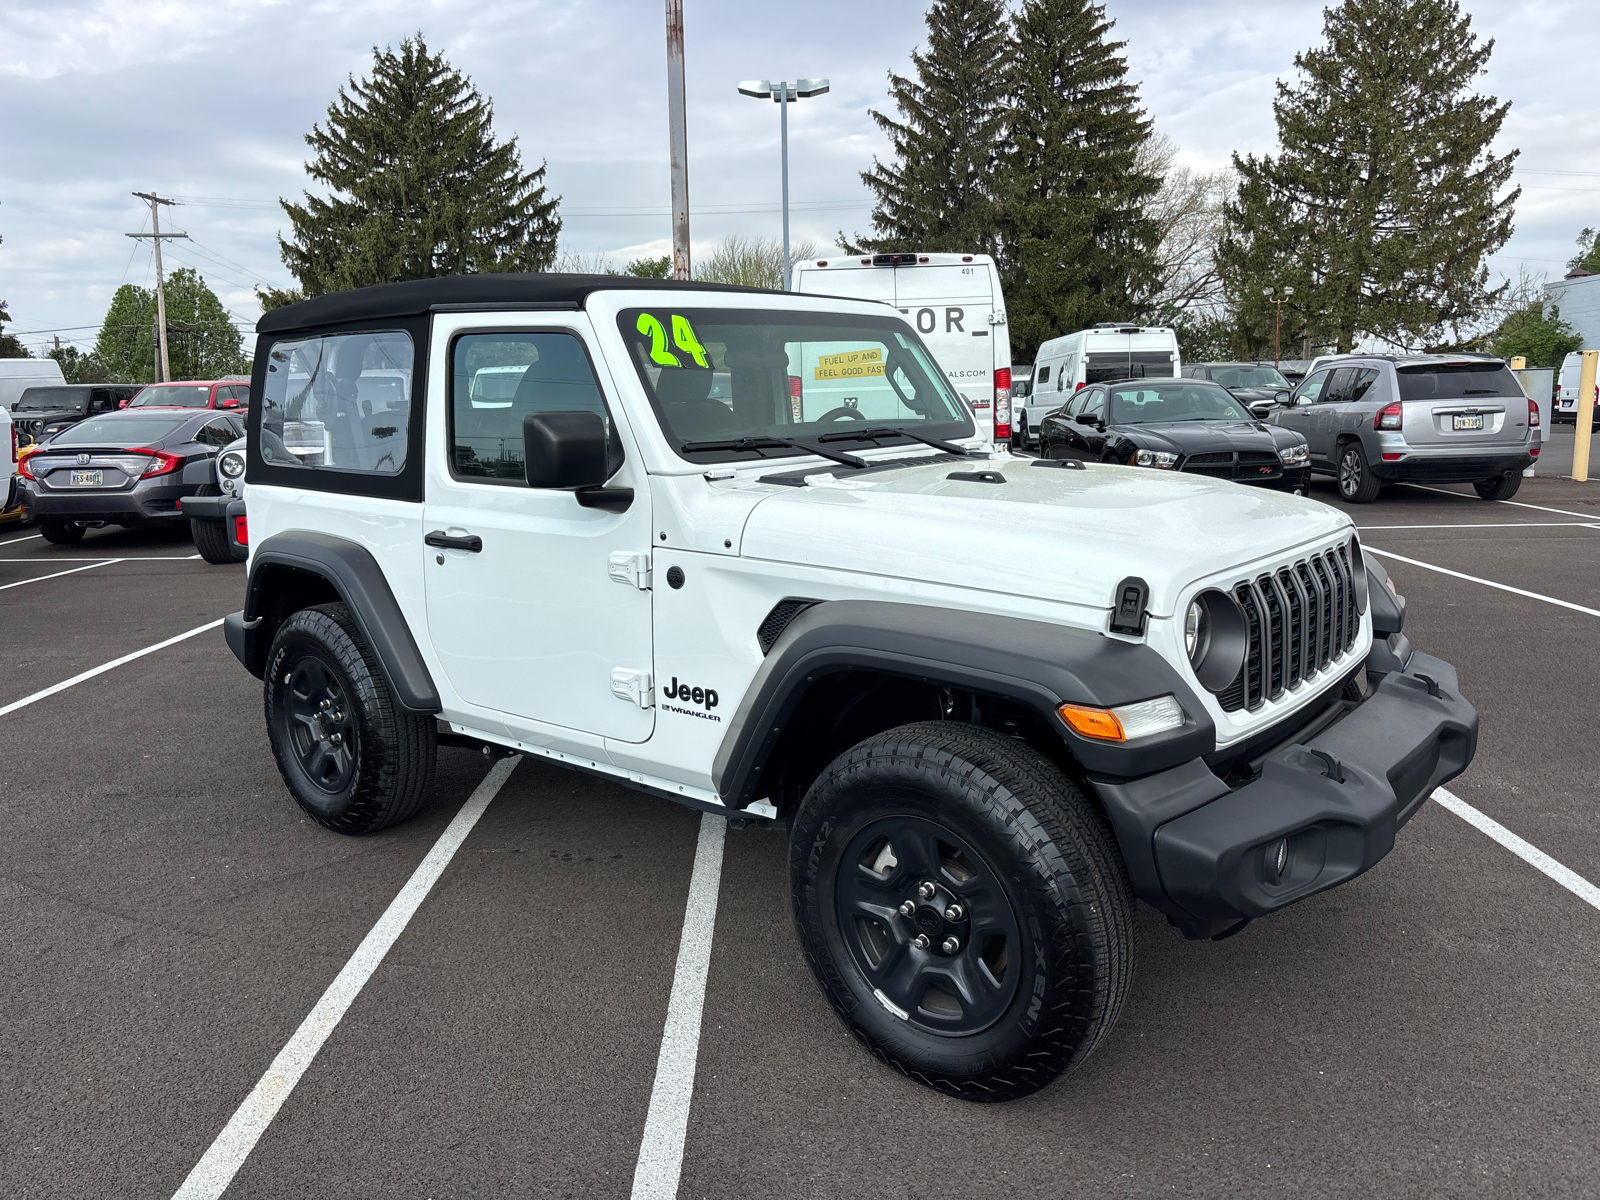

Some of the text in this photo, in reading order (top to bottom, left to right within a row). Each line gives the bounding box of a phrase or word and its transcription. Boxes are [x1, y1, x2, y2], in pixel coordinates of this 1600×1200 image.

[636, 313, 709, 369] 24
[824, 351, 878, 365] FUEL UP AND
[819, 369, 838, 377] FEEL
[841, 367, 863, 376] GOOD
[946, 370, 986, 378] ALS.COM
[663, 676, 719, 711] Jeep
[670, 705, 721, 722] WRANGLER
[807, 821, 834, 882] HTX2
